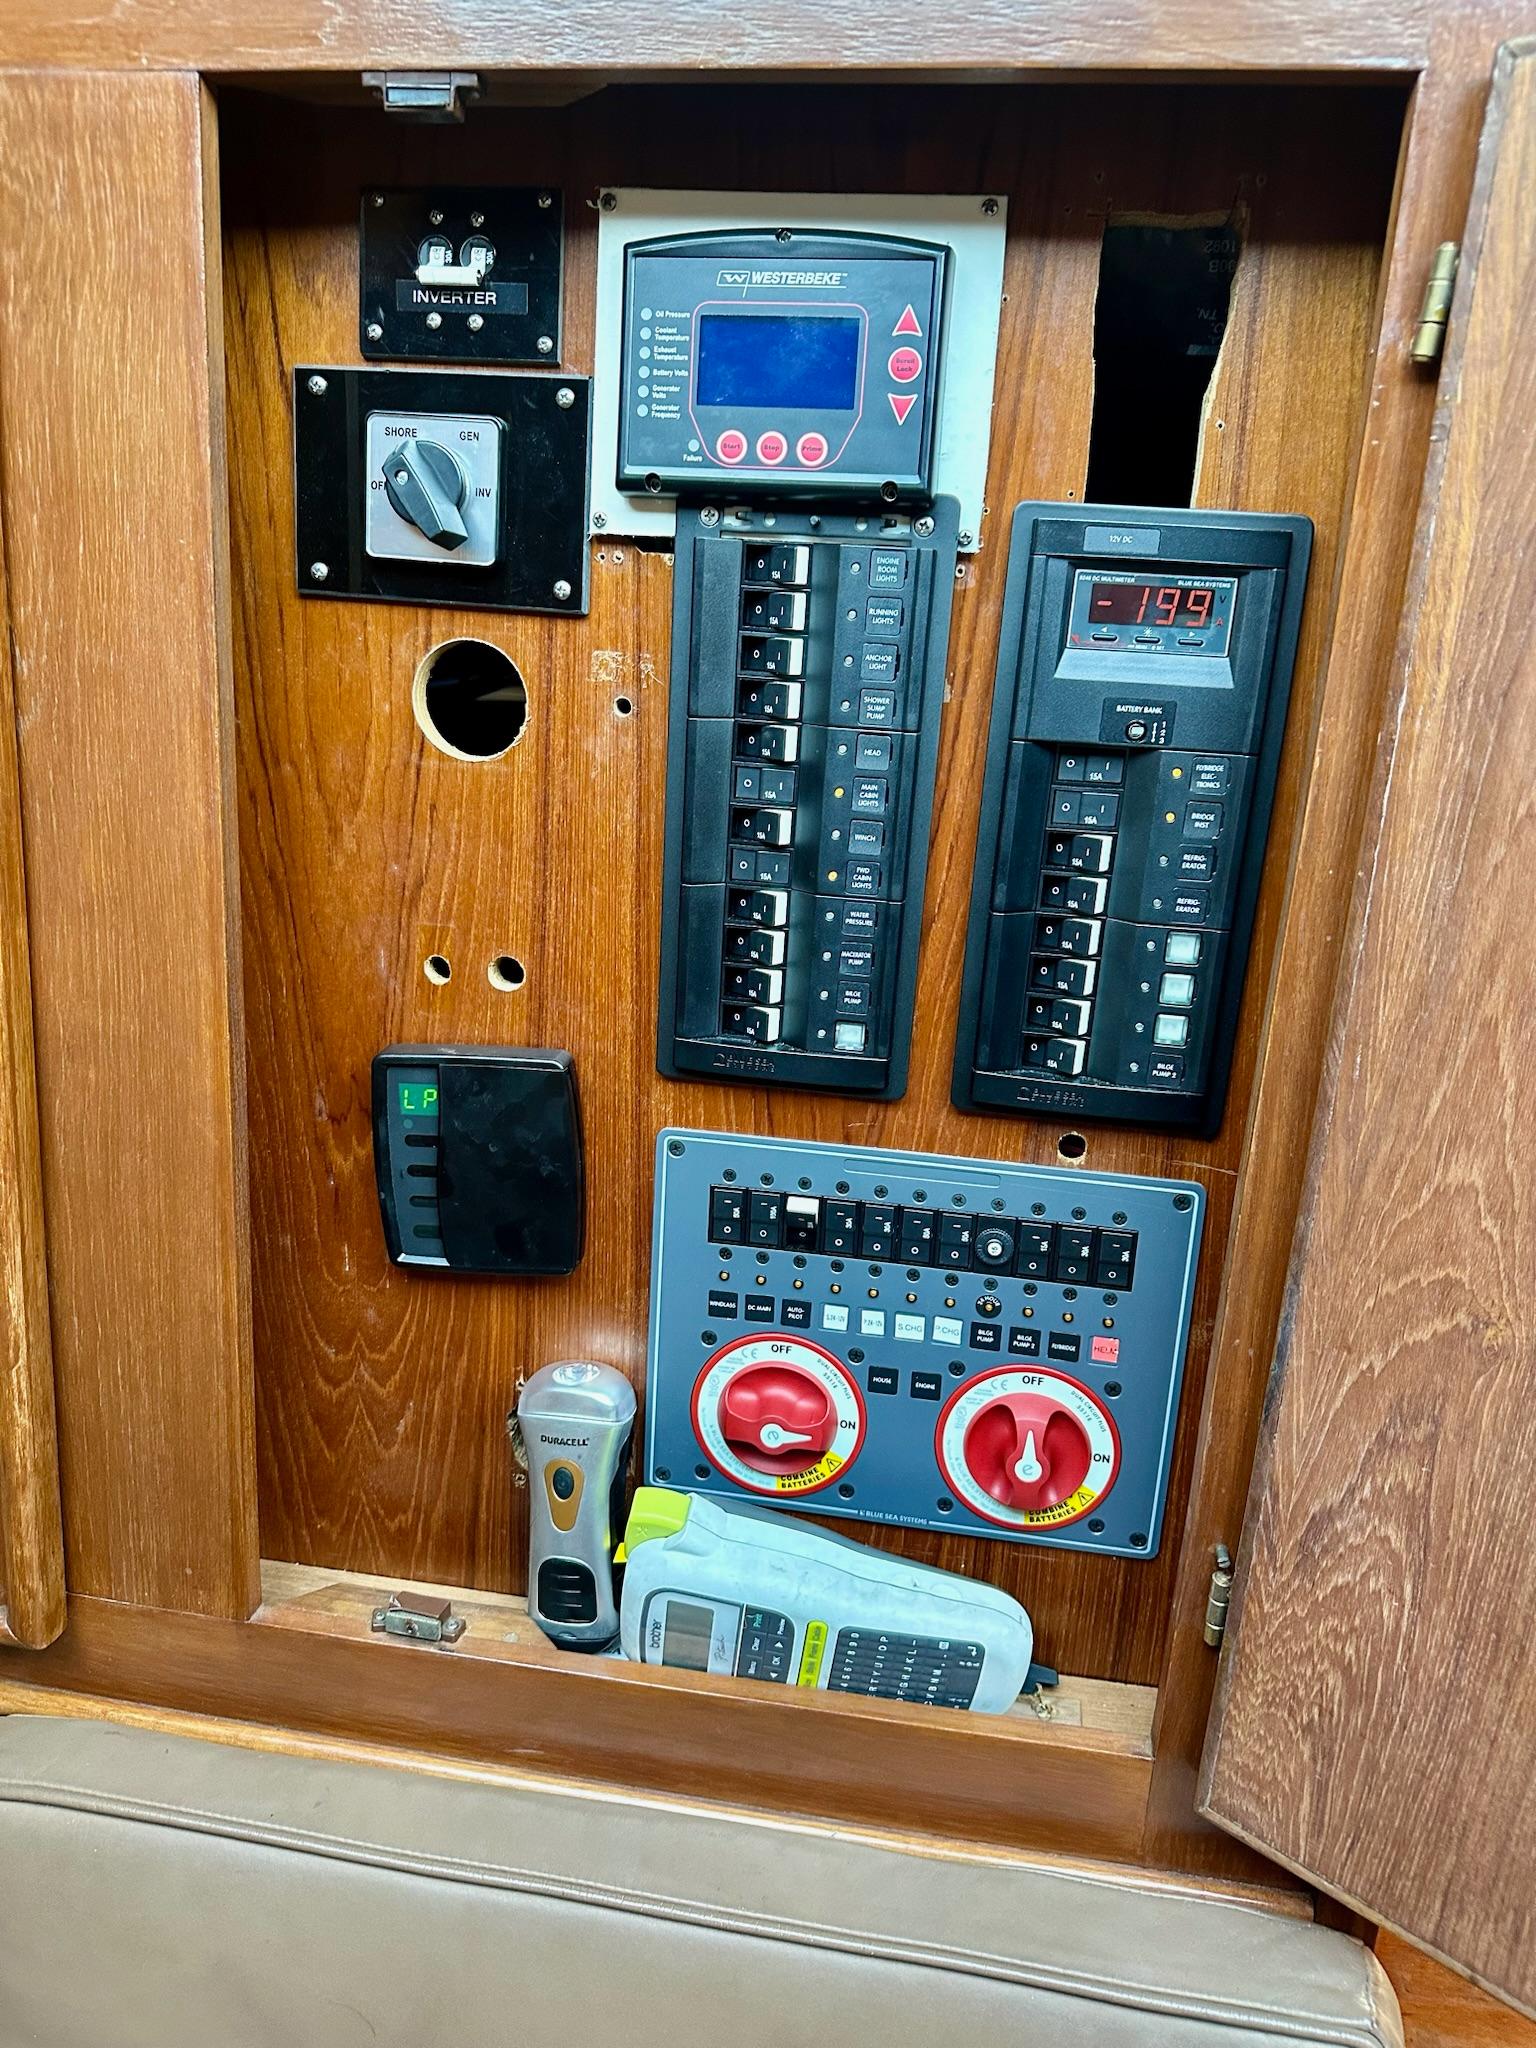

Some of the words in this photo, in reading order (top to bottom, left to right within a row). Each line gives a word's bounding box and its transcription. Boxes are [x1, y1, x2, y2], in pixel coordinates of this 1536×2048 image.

[751, 272, 842, 285] WESTERBEKE
[412, 290, 497, 305] INVERTER
[655, 310, 664, 318] Oil
[665, 310, 690, 318] Pressure
[655, 326, 677, 334] Coolant
[654, 334, 690, 342] Temperature
[654, 352, 688, 361] Temperature
[653, 368, 674, 378] Battery
[652, 384, 680, 392] Generator
[652, 410, 680, 420] Frequency
[384, 426, 418, 438] SHORE
[459, 430, 480, 442] GEN
[683, 454, 702, 462] Failure
[371, 481, 386, 490] OF
[475, 487, 492, 498] INV
[1109, 535, 1120, 543] 12V
[1122, 536, 1133, 544] DC
[876, 556, 900, 566] ENGINE
[877, 565, 898, 574] ROOM
[772, 571, 780, 579] 15A
[876, 574, 898, 582] LIGHTS
[1101, 576, 1136, 584] MULTIMETER
[868, 608, 898, 616] RUNNING
[770, 617, 778, 625] 15A
[872, 616, 894, 625] LIGHTS
[864, 654, 892, 663] ANCHOR
[767, 662, 776, 670] 15A
[869, 662, 887, 670] LIGHT
[864, 696, 890, 705] SHOWER
[764, 706, 773, 714] 15A
[866, 704, 886, 712] SUMP
[1116, 704, 1143, 714] BATTERY
[1144, 706, 1163, 715] BANK
[866, 712, 885, 720] PUMP
[762, 748, 770, 756] 15A
[864, 748, 882, 756] HEAD
[1196, 764, 1224, 772] FLYBRIDGE
[1090, 772, 1102, 780] 15A
[860, 784, 878, 792] MAIN
[1196, 781, 1220, 789] TRONICS
[764, 791, 776, 799] 15A
[860, 791, 879, 799] CABIN
[858, 800, 879, 808] LIGHTS
[1084, 816, 1097, 824] 15A
[1191, 812, 1215, 821] BRIDGE
[1194, 821, 1210, 829] INST
[757, 832, 766, 840] 15A
[854, 834, 876, 842] WINCH
[1072, 858, 1082, 866] 15A
[1182, 862, 1206, 871] ERATOR
[856, 866, 870, 874] FWD
[853, 874, 872, 882] CABIN
[852, 882, 872, 890] LIGHTS
[1067, 900, 1078, 909] 15A
[1176, 904, 1200, 914] ERATOR
[753, 912, 762, 920] 15A
[850, 911, 870, 919] WATER
[845, 918, 873, 927] PRESSURE
[1062, 940, 1072, 950] 15A
[750, 951, 759, 960] 15A
[840, 950, 872, 960] MACERATOR
[848, 958, 864, 966] PUMP
[1057, 980, 1068, 990] 15A
[748, 989, 757, 998] 15A
[844, 997, 862, 1006] PUMP
[1052, 1020, 1062, 1030] 15A
[746, 1027, 755, 1036] 15A
[1047, 1060, 1058, 1069] 15A
[1157, 1062, 1174, 1070] BILGE
[1152, 1070, 1170, 1078] PUMP
[1040, 1241, 1048, 1252] 15A
[710, 1300, 736, 1308] WINDLASS
[984, 1296, 1000, 1306] HOUR
[977, 1328, 993, 1336] BILGE
[976, 1335, 994, 1344] PUMP
[1016, 1334, 1032, 1342] BILGE
[1012, 1340, 1030, 1348] PUMP
[1052, 1343, 1076, 1352] FLYBRIDGE
[771, 1344, 792, 1354] OFF
[873, 1376, 892, 1384] HOUSE
[1022, 1375, 1044, 1386] OFF
[915, 1382, 936, 1390] ENGINE
[1071, 1390, 1084, 1402] DUAL
[1084, 1401, 1102, 1420] CIRCUIT
[840, 1420, 856, 1430] ON
[540, 1435, 590, 1446] DURACELL
[1093, 1453, 1110, 1464] ON
[780, 1466, 818, 1481] COMBINE
[782, 1472, 826, 1488] BATTERIES
[866, 1510, 884, 1519] BLUE
[900, 1515, 928, 1524] SYSTEMS
[1030, 1507, 1076, 1522] BATTERIES
[753, 1613, 764, 1628] Print
[650, 1619, 662, 1649] brother
[752, 1636, 760, 1651] Clear
[772, 1656, 781, 1665] OK
